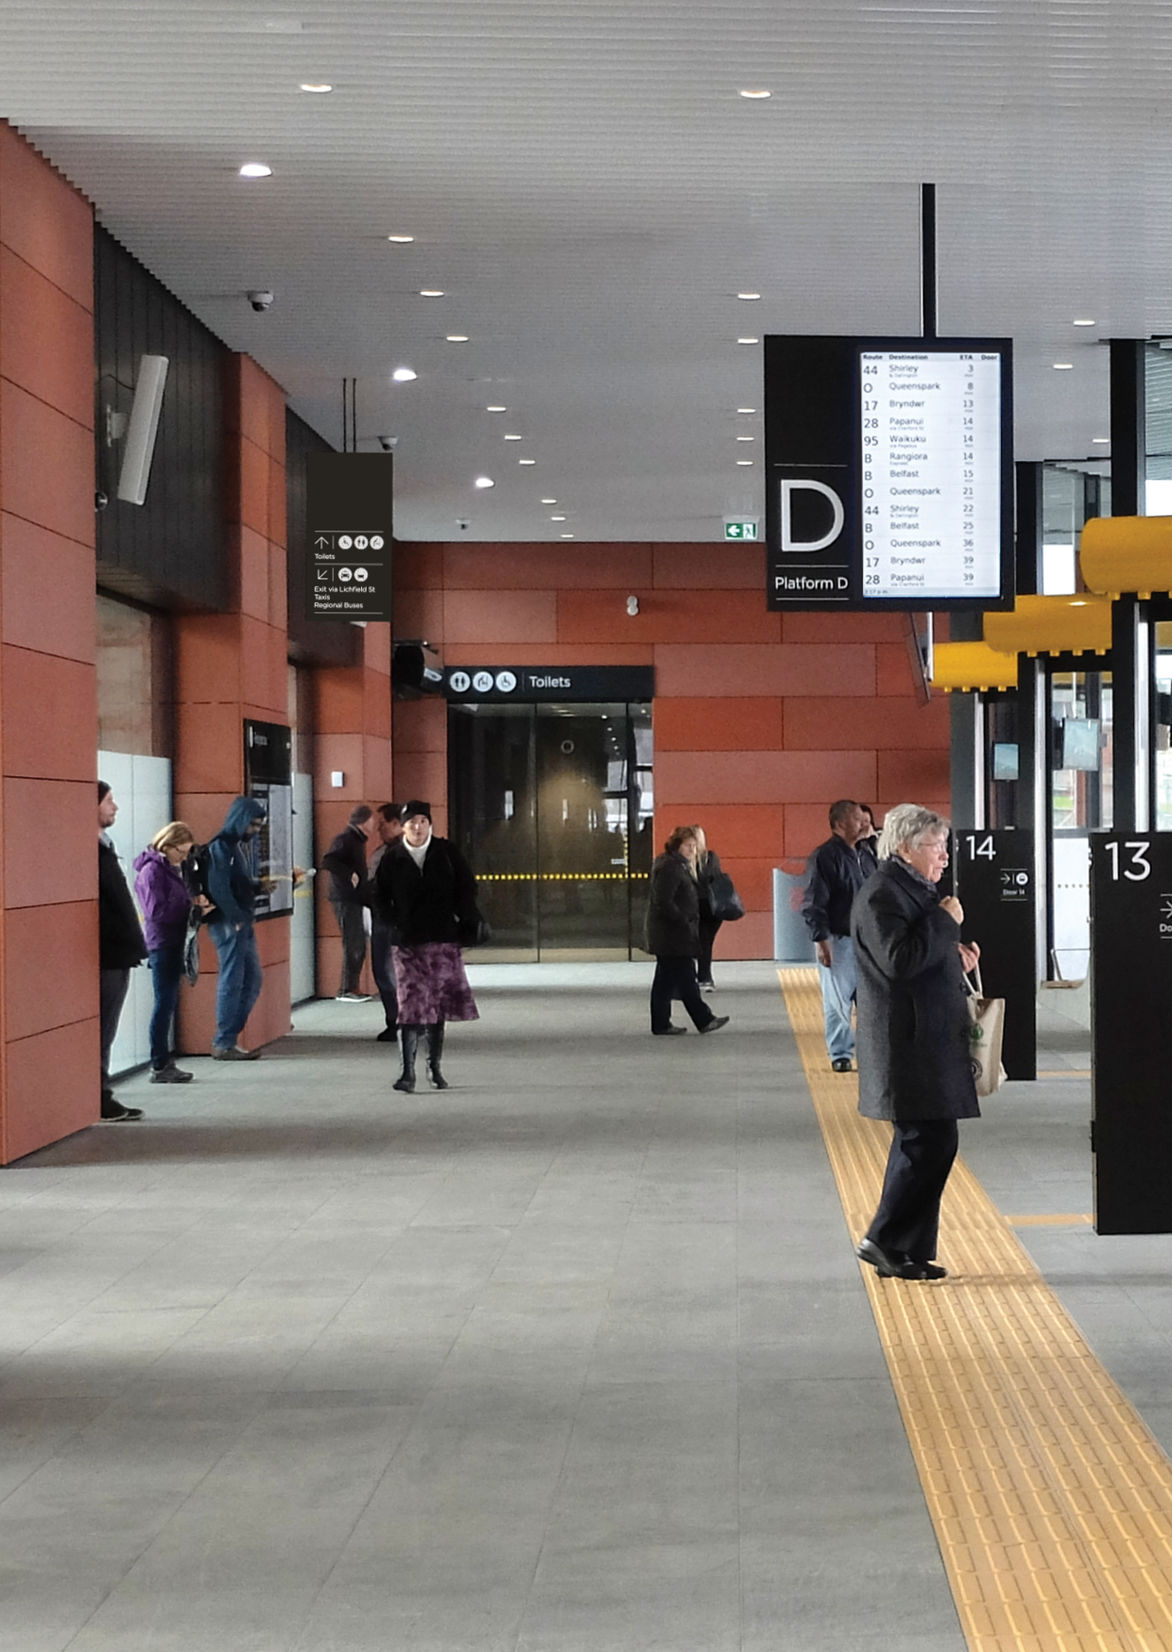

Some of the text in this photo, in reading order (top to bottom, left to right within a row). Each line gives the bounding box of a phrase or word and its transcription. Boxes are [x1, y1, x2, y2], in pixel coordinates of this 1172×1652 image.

[863, 364, 974, 375] 44 Shirley 3
[888, 382, 941, 391] Queenspark
[967, 382, 974, 390] 8
[864, 400, 974, 411] 17 Bryndwr 13
[864, 418, 879, 429] 28
[889, 417, 924, 426] Papanui
[963, 417, 973, 425] 14
[864, 435, 879, 446] 95
[889, 435, 927, 443] Waikuku
[963, 434, 973, 443] 14
[864, 452, 973, 464] B Rangiora 14
[864, 469, 974, 481] B Belfast 15
[889, 487, 941, 496] Queenspark
[963, 487, 973, 495] 21
[780, 479, 845, 552] D
[864, 504, 974, 515] 44 Shirley 22
[865, 521, 974, 533] B Belfast 25
[890, 539, 942, 548] Queenspark
[963, 539, 974, 547] 36
[866, 556, 974, 568] 17 Bryndwr 39
[774, 576, 848, 590] Platform D
[865, 575, 880, 585] 28
[890, 573, 925, 582] Papanui
[963, 573, 974, 581] 39
[529, 675, 571, 688] Toilets
[966, 835, 996, 860] 14
[1105, 841, 1151, 881] 13
[1002, 888, 1017, 896] Door
